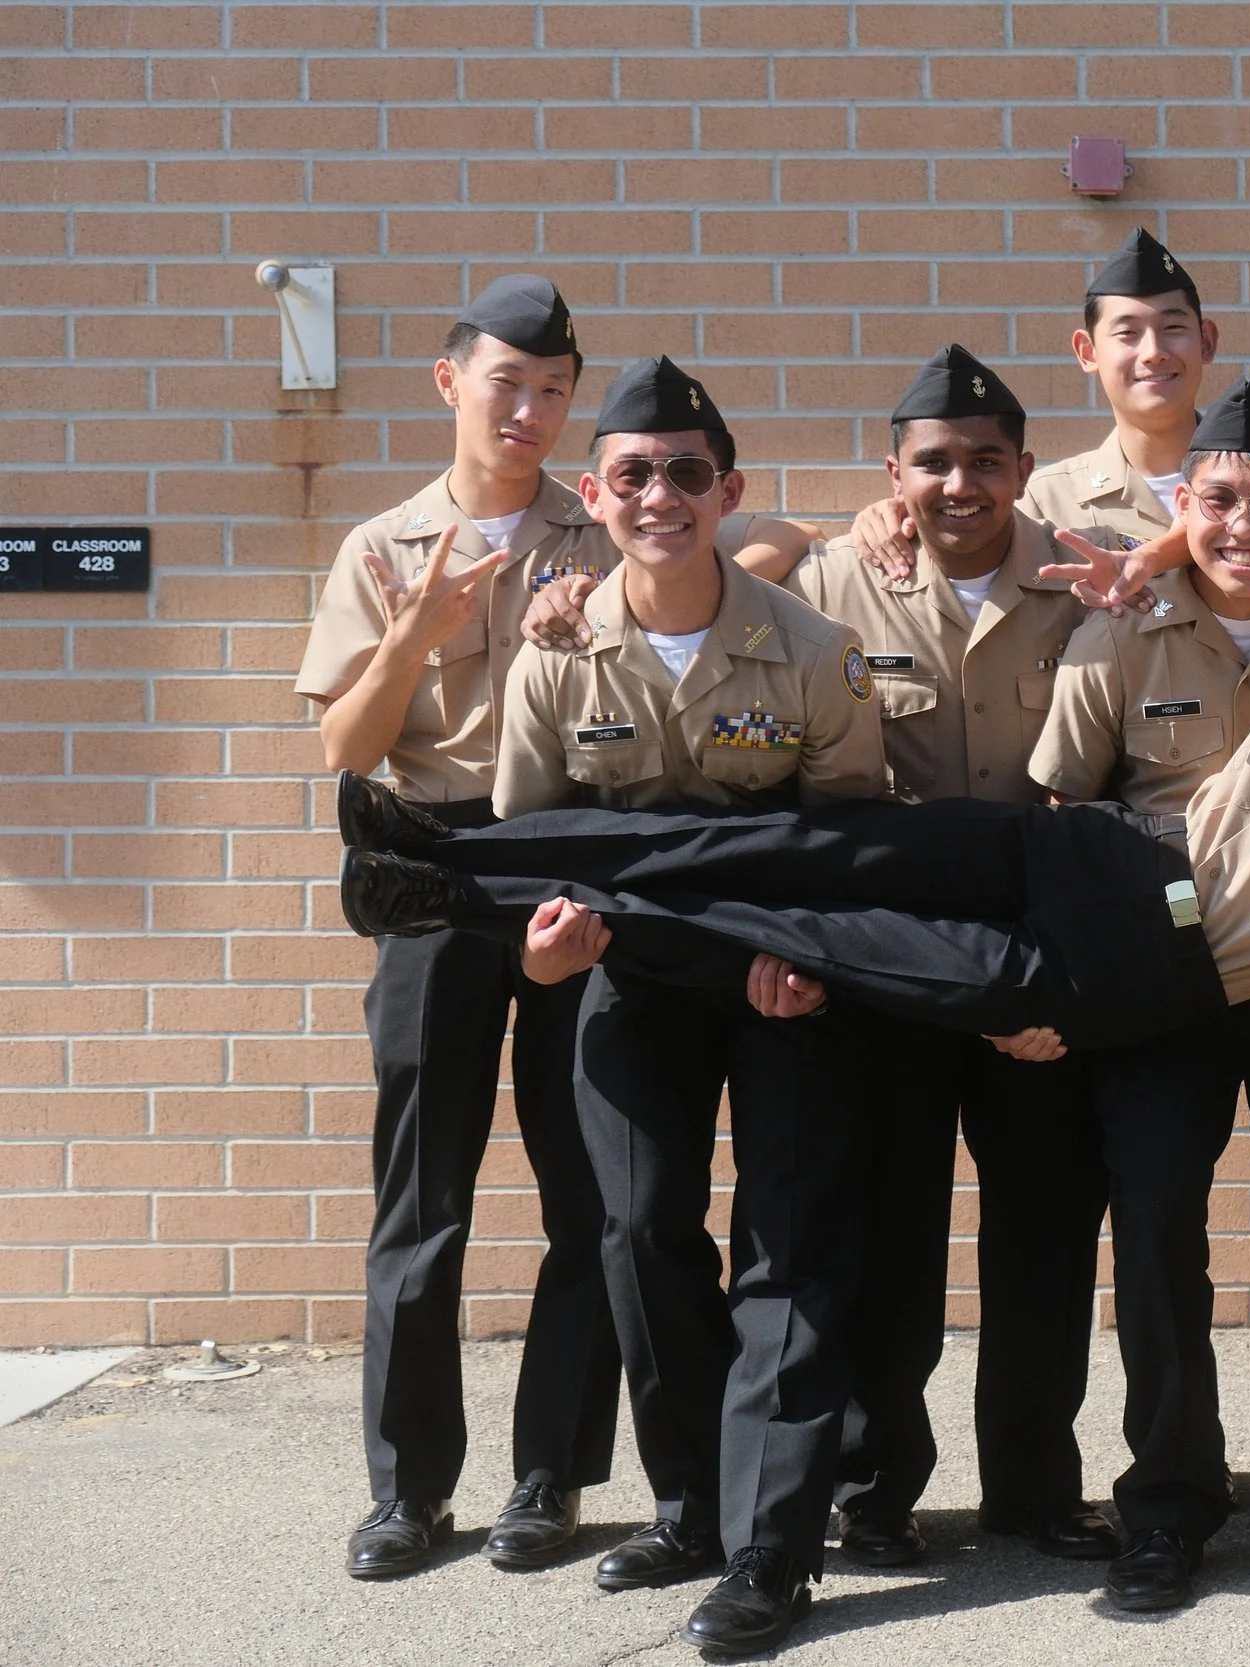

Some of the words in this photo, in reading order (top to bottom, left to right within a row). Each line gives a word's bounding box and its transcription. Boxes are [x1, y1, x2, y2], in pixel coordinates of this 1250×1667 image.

[0, 540, 36, 552] OOM
[52, 540, 142, 552] CLASSROOM
[79, 556, 115, 571] 428
[875, 658, 897, 666] REDDY
[1161, 705, 1183, 714] HSIEH
[595, 730, 617, 739] CHIEN
